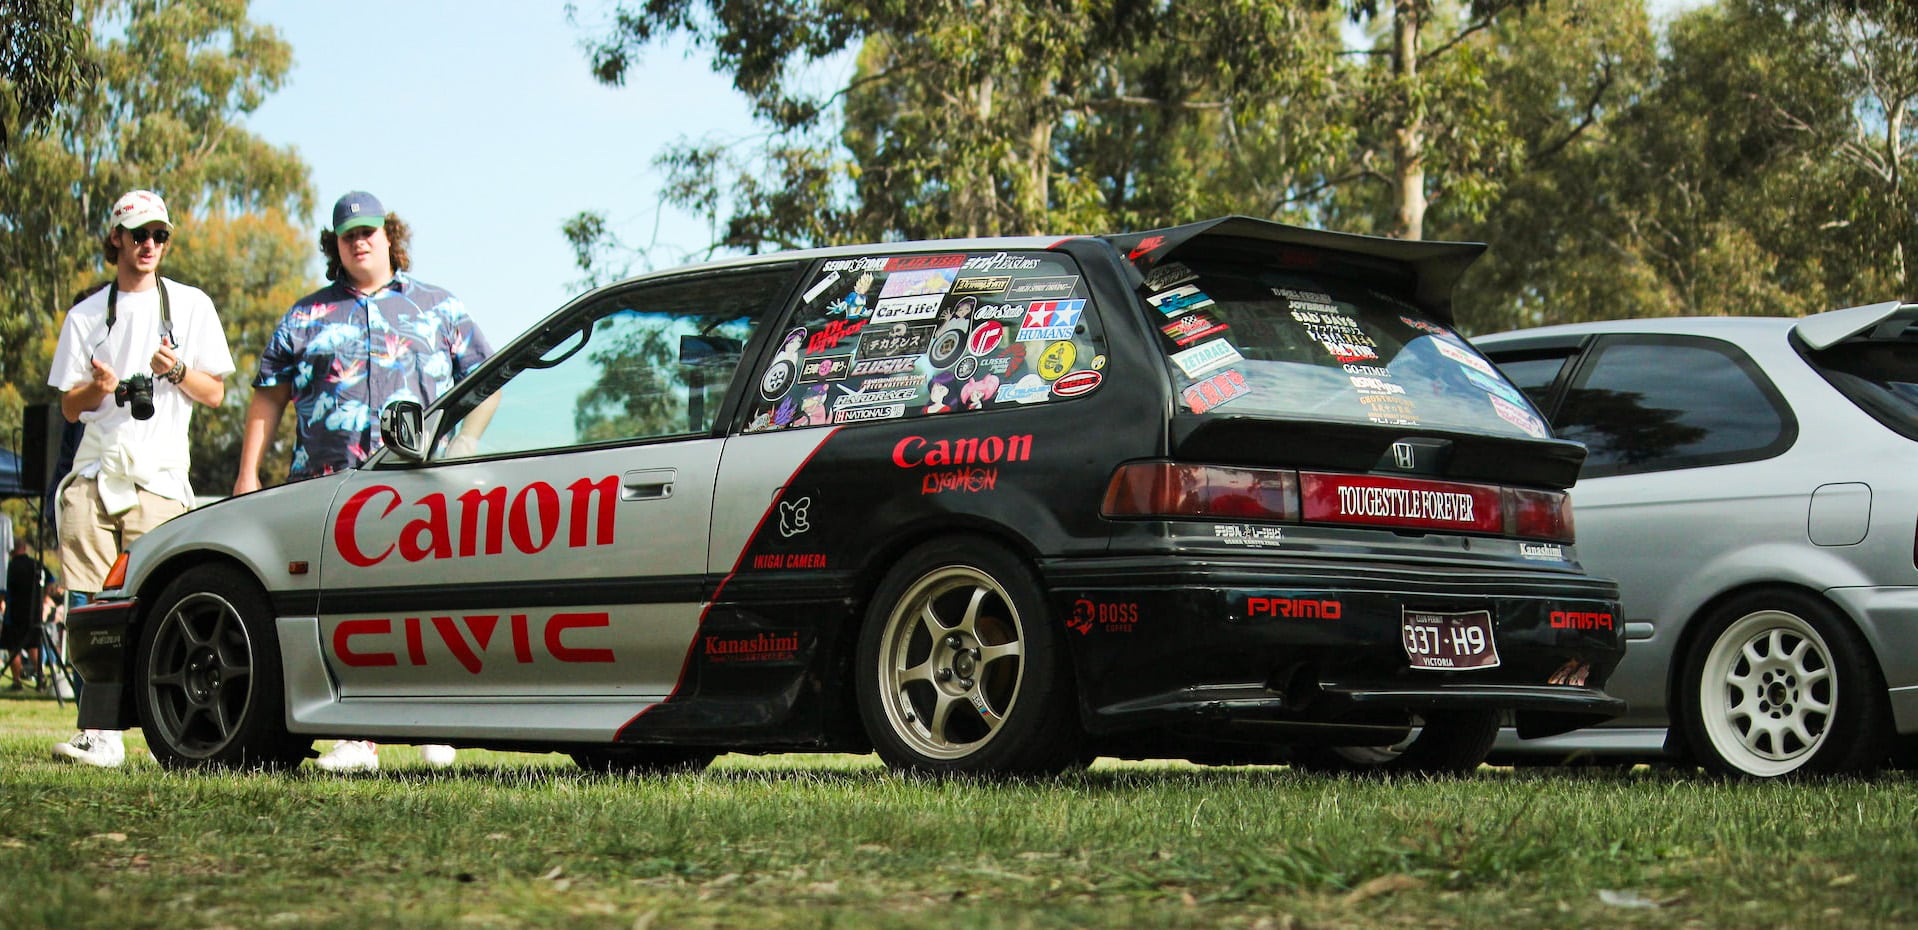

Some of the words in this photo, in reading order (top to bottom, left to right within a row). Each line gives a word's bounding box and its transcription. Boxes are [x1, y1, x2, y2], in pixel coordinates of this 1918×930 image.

[1018, 327, 1073, 340] HUMANS
[1342, 363, 1391, 377] GO-TIME!
[834, 388, 916, 407] HARDRACE
[845, 407, 892, 419] NATIONALS
[892, 434, 1033, 468] Canon
[1338, 486, 1421, 518] TOUGESTYLE
[1421, 490, 1475, 521] FOREVER
[334, 475, 620, 567] Canon
[1520, 543, 1562, 557] Kanashimi
[754, 555, 784, 568] IKIGAI
[787, 554, 827, 568] CAMERA
[1099, 603, 1138, 623] BOSS
[1247, 597, 1342, 619] PRIMO
[333, 612, 616, 674] CIVIC
[704, 631, 799, 655] Kanashimi
[1423, 657, 1454, 667] VICTORIA
